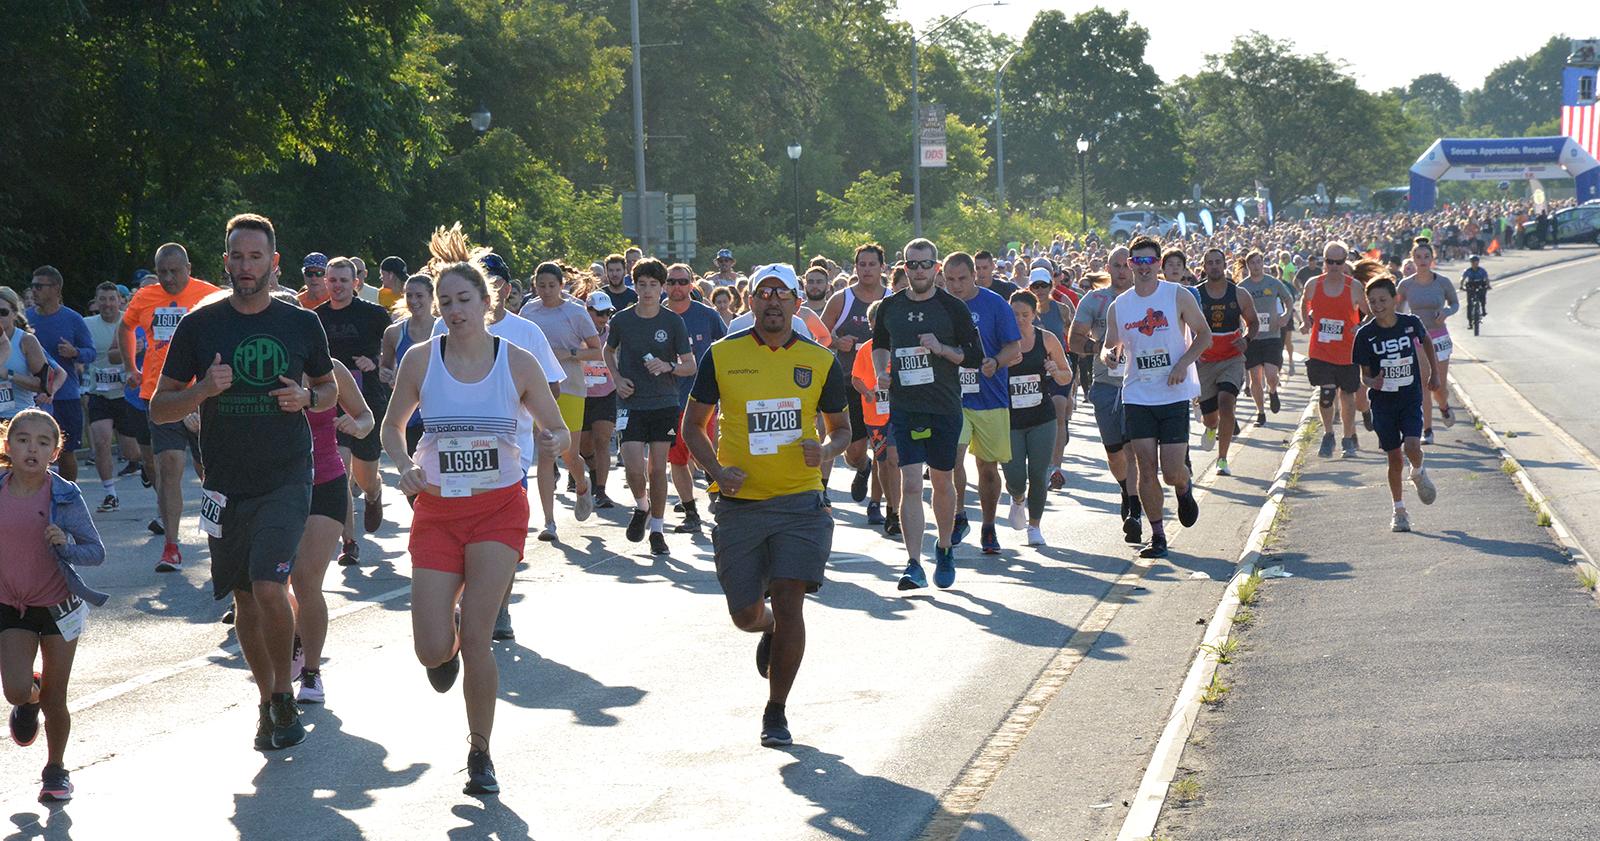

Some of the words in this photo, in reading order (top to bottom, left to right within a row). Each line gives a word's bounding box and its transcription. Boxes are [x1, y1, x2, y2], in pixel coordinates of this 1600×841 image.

[1372, 336, 1411, 355] USA
[900, 355, 929, 370] 18014
[1140, 355, 1168, 369] 17554
[1384, 365, 1411, 378] 16940
[1013, 382, 1040, 395] 17342
[753, 411, 797, 431] 17208
[437, 424, 474, 433] balance
[444, 450, 493, 472] 16931
